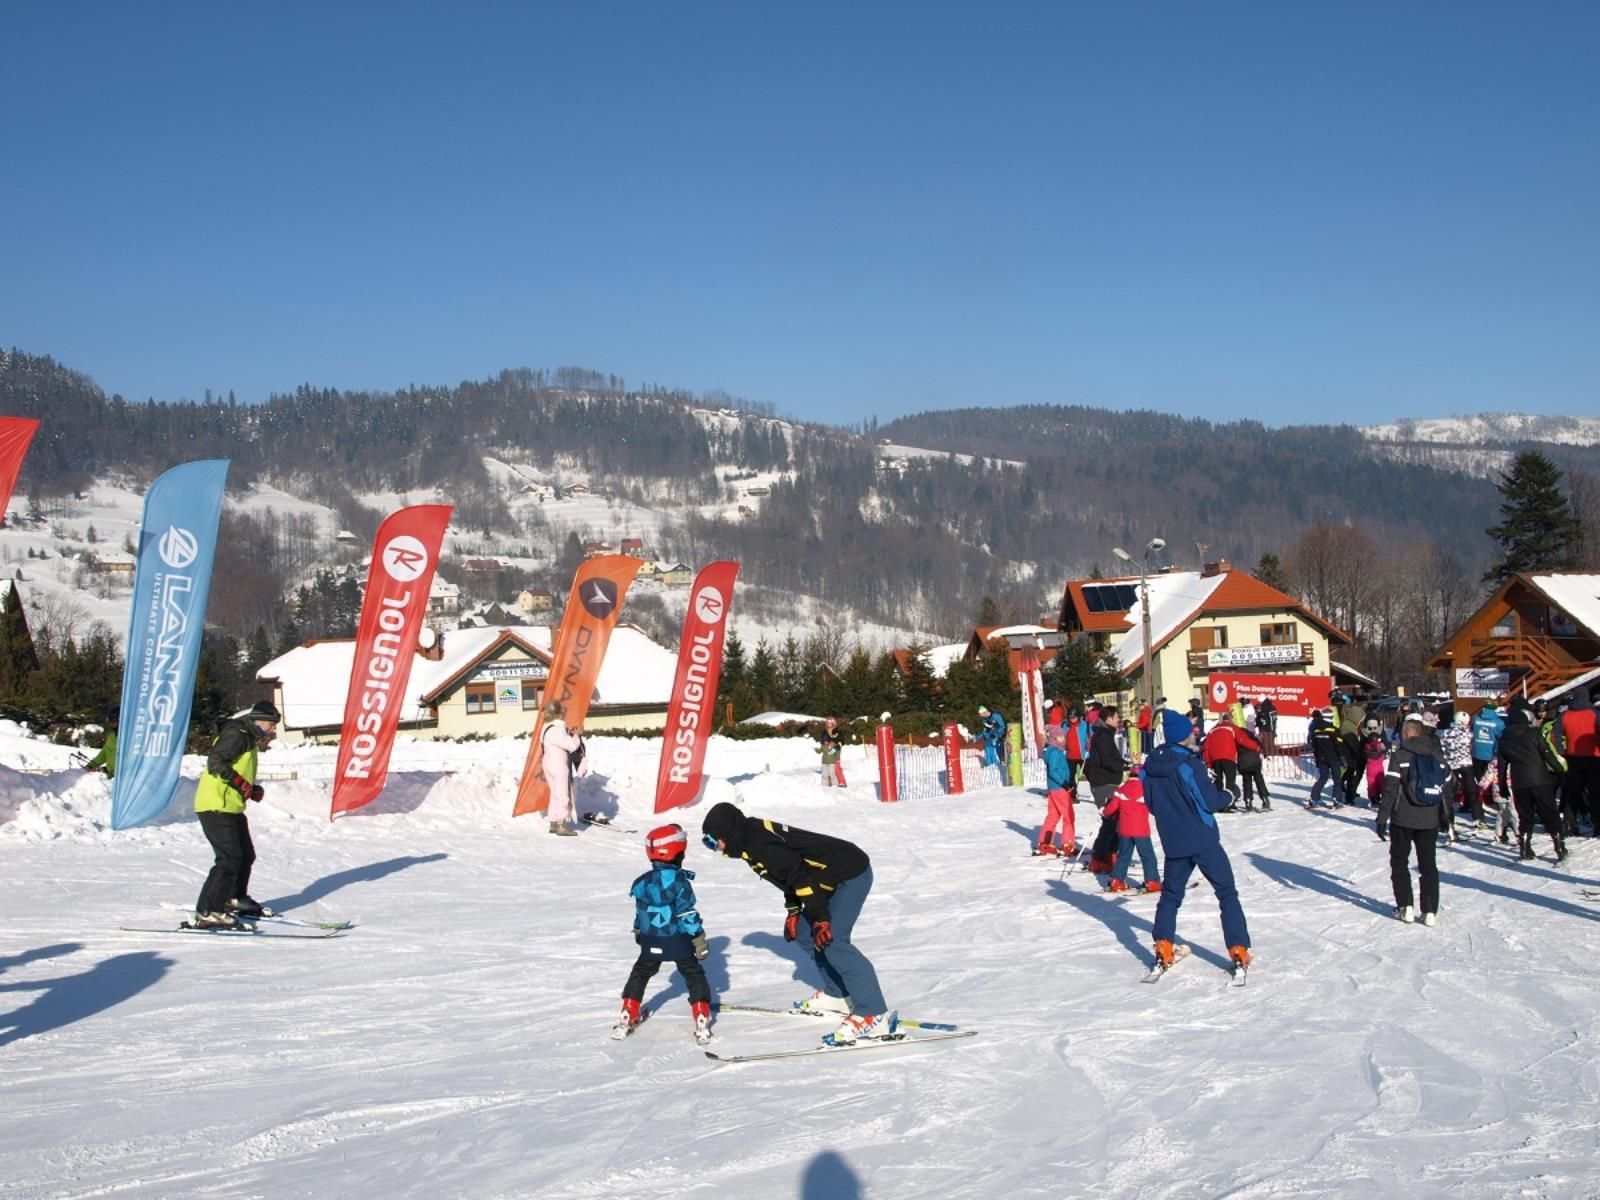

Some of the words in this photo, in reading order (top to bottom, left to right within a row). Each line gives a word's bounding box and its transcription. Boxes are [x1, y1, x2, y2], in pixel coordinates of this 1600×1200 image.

[144, 573, 193, 757] LANGE
[146, 572, 163, 634] ULTIMATE
[343, 591, 411, 779] ROSSIGNOL
[669, 630, 715, 784] ROSSIGNOL
